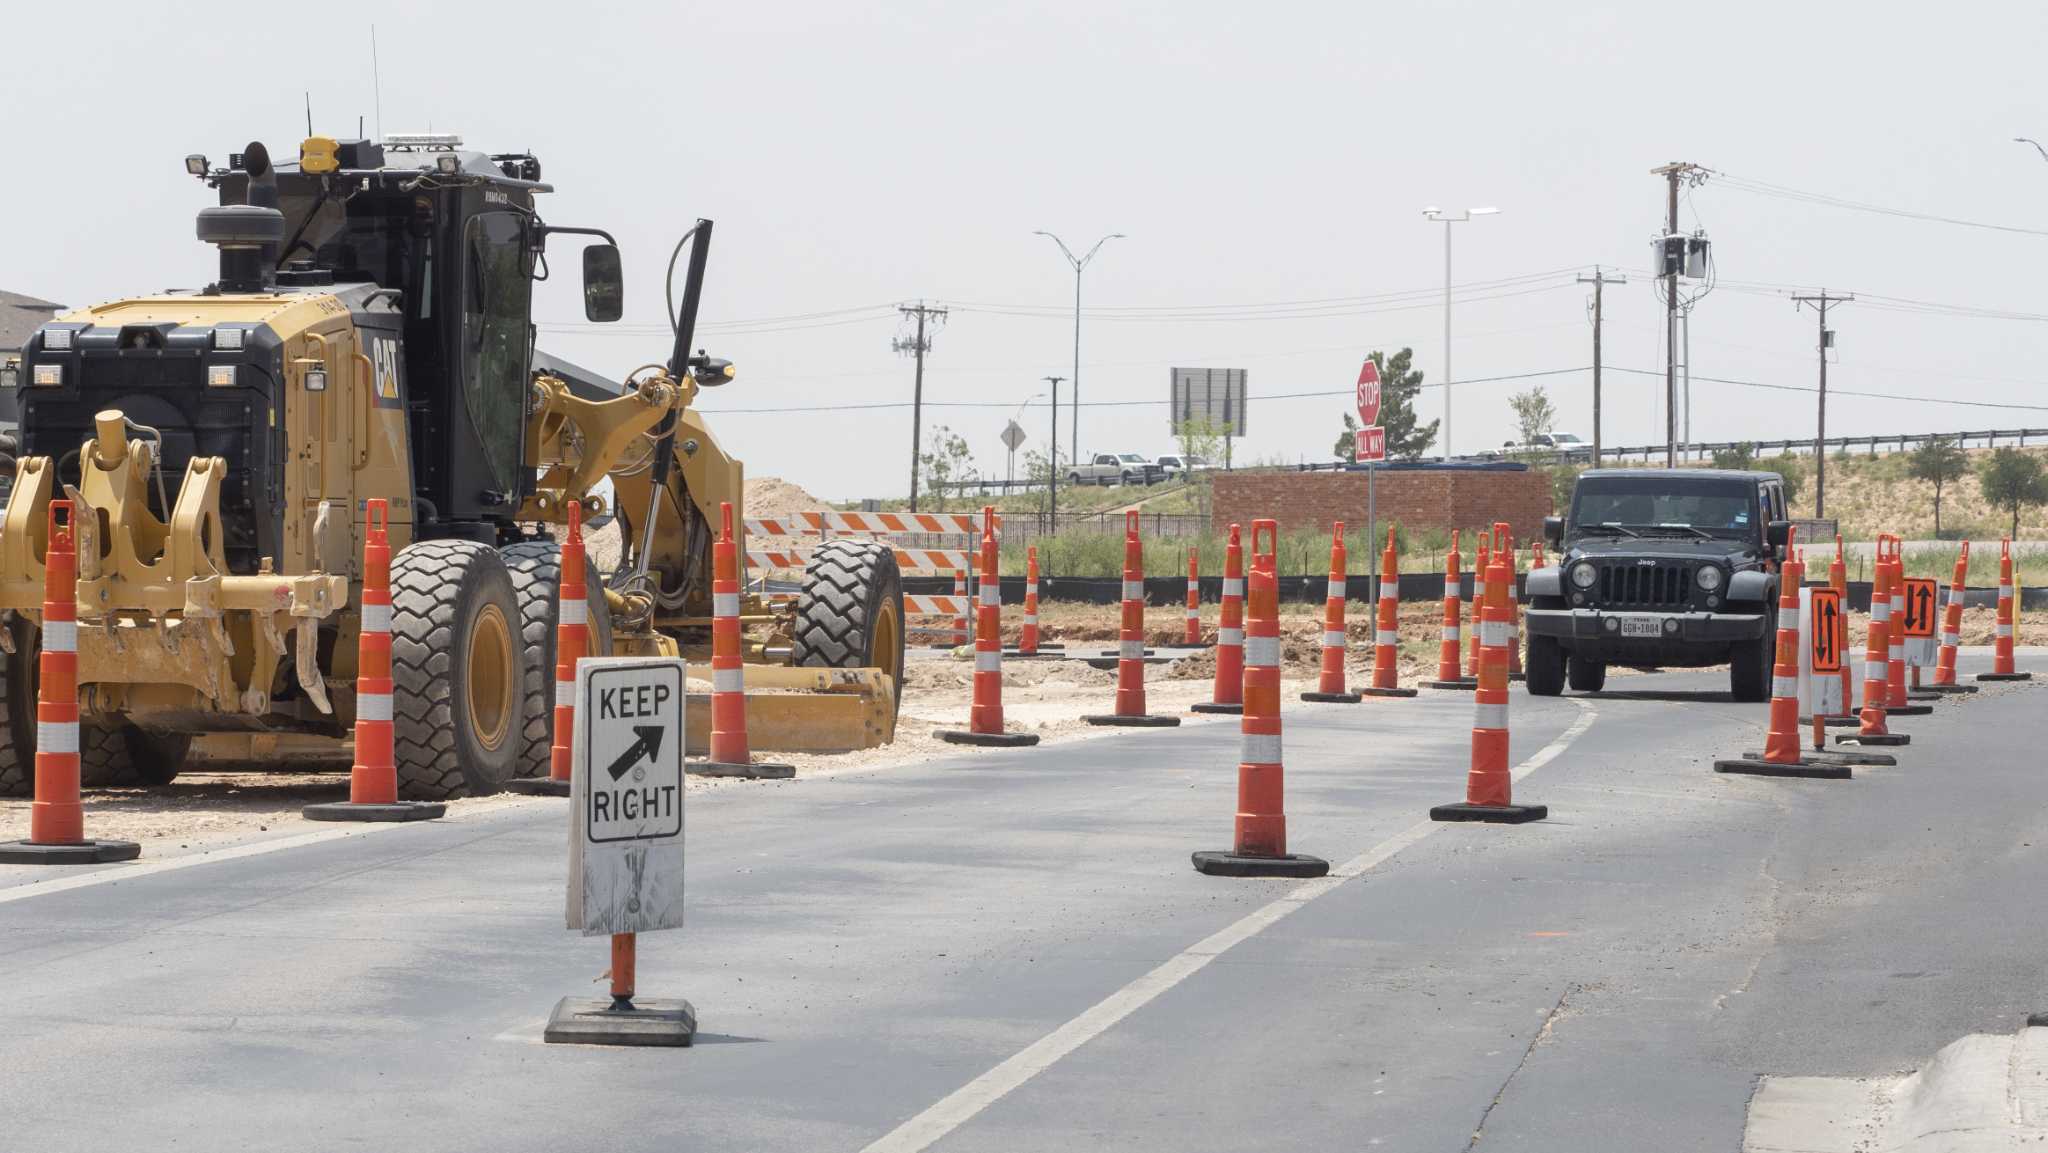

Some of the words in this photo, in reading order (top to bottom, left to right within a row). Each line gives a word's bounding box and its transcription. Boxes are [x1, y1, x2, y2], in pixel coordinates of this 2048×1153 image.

[373, 337, 399, 399] CAT
[1358, 382, 1379, 407] STOP
[1637, 558, 1656, 567] Jeep
[600, 684, 670, 720] KEEP
[594, 786, 676, 823] RIGHT
